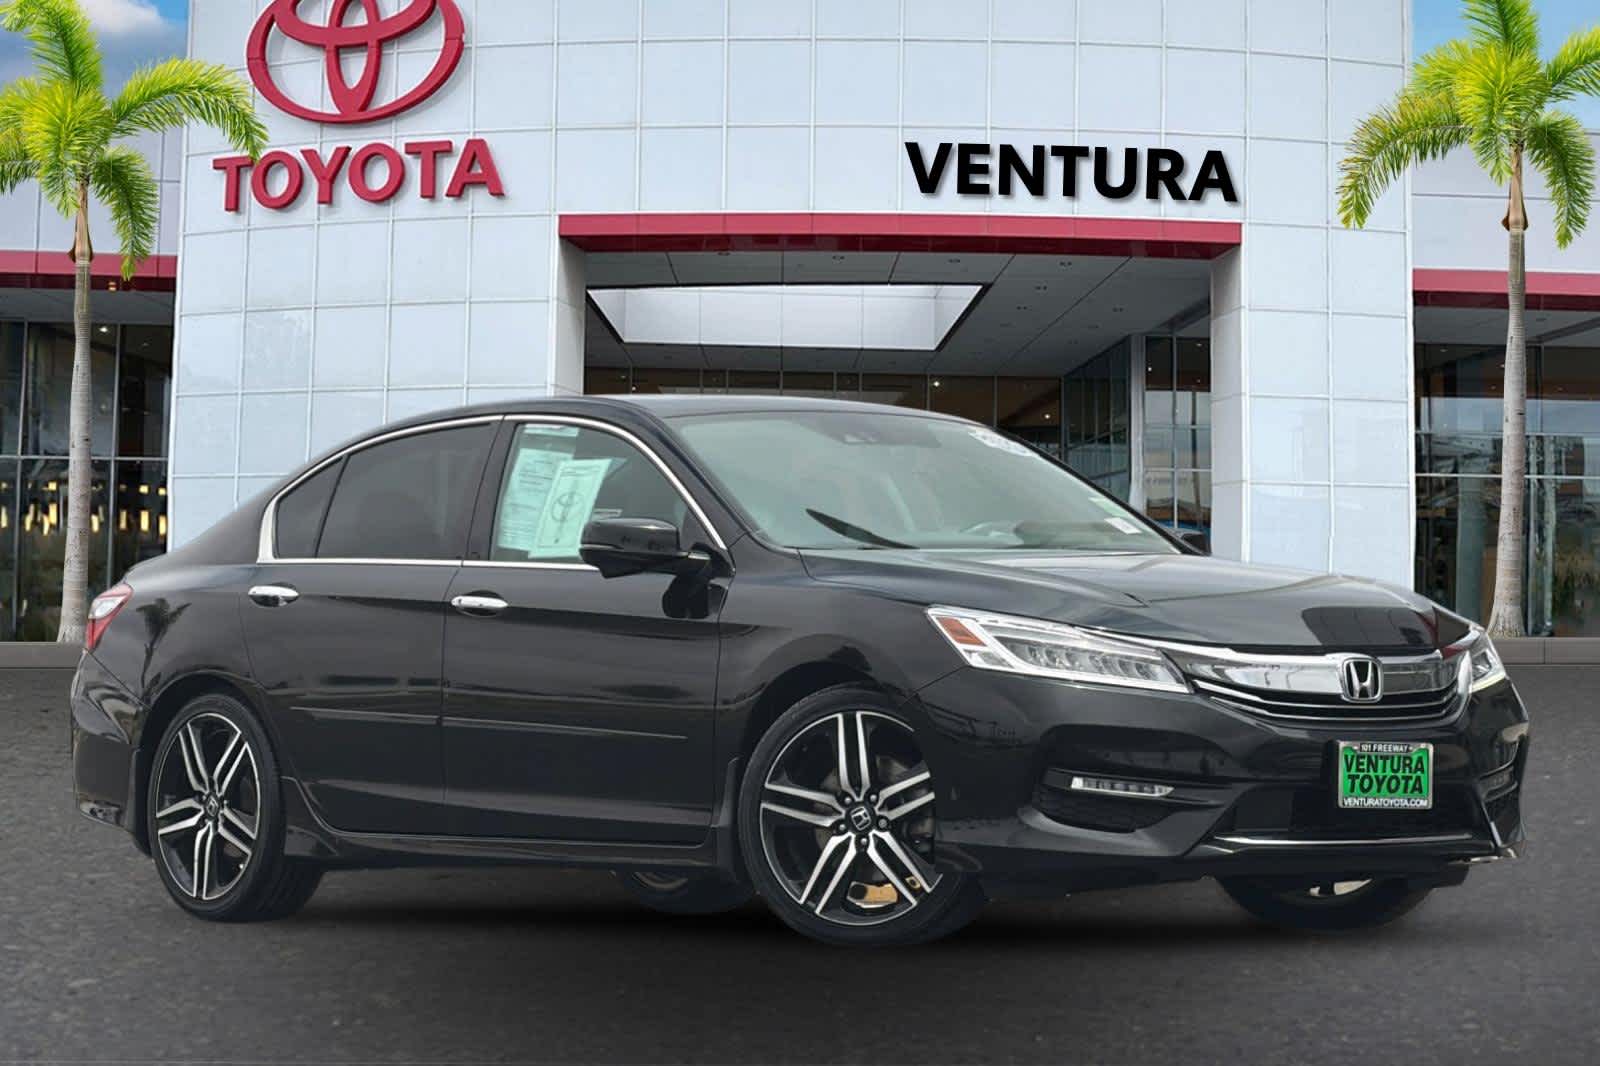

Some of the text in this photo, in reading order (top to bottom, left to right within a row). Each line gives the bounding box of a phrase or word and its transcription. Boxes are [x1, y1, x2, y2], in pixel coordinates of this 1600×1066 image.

[213, 138, 504, 211] TOYOTA
[904, 142, 1239, 202] VENTURA
[1361, 744, 1408, 752] 101 FREEWAY
[1343, 754, 1425, 774] VENTURA
[1348, 774, 1423, 794] TOYOTA
[1343, 798, 1428, 807] VENTURATOYOTA.COM
